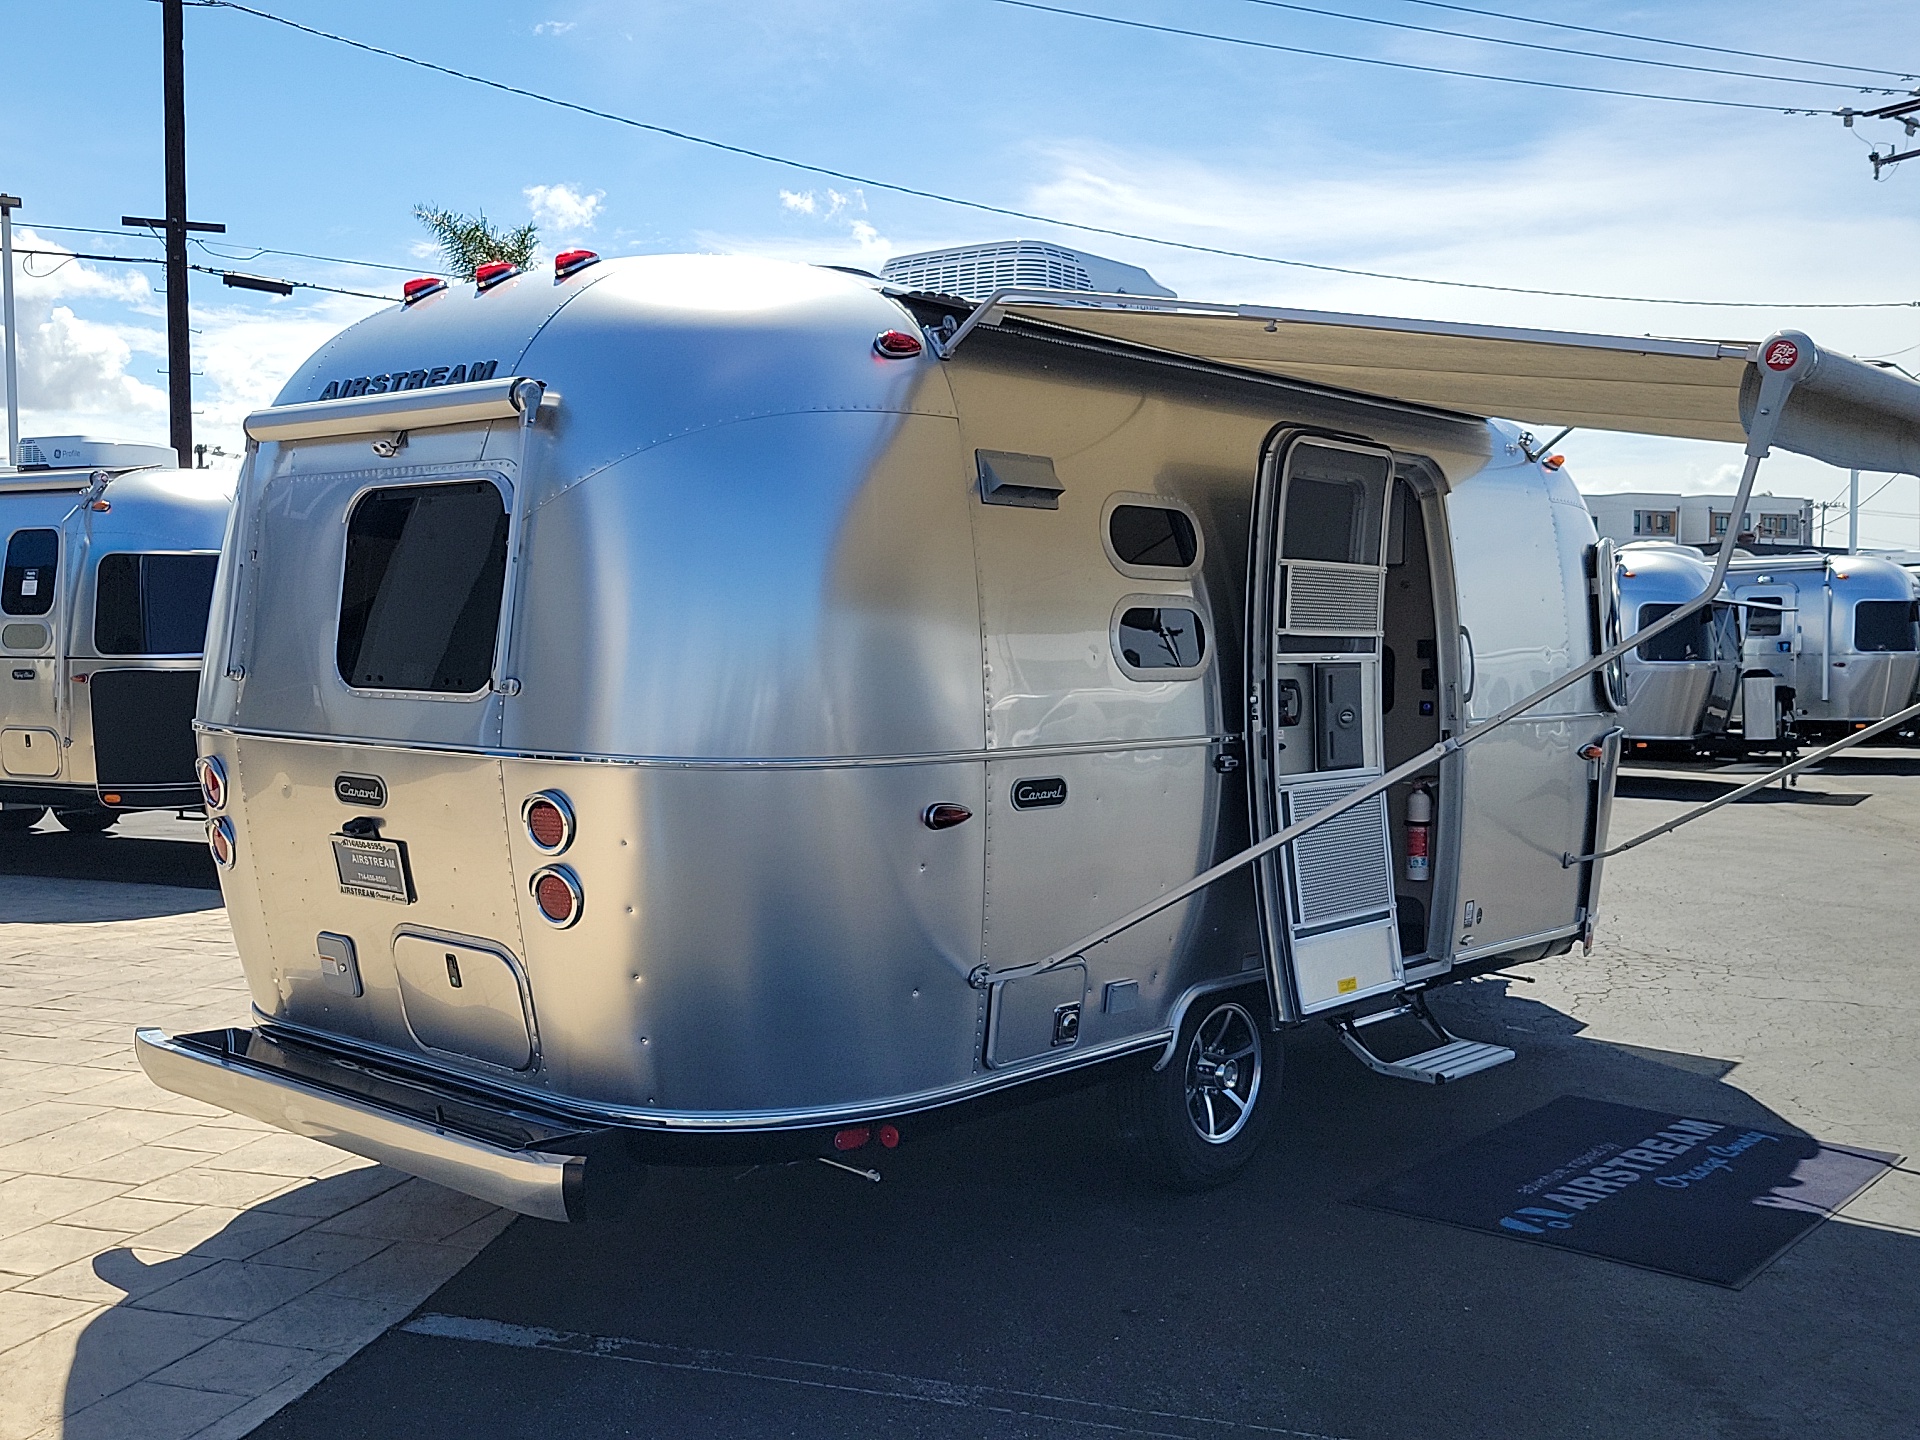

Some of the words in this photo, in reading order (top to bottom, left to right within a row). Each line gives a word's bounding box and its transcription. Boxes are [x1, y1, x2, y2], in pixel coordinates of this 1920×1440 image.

[1772, 344, 1796, 357] Zip
[318, 358, 499, 401] AIRSTREAM
[62, 449, 80, 457] Profile
[338, 781, 381, 799] Caravel
[1018, 785, 1063, 801] Caravel
[352, 854, 395, 868] AIRSTREAM
[340, 885, 376, 898] AIRSTREAM
[1543, 1118, 1726, 1210] AIRSTREAM
[1654, 1156, 1733, 1188] Orange
